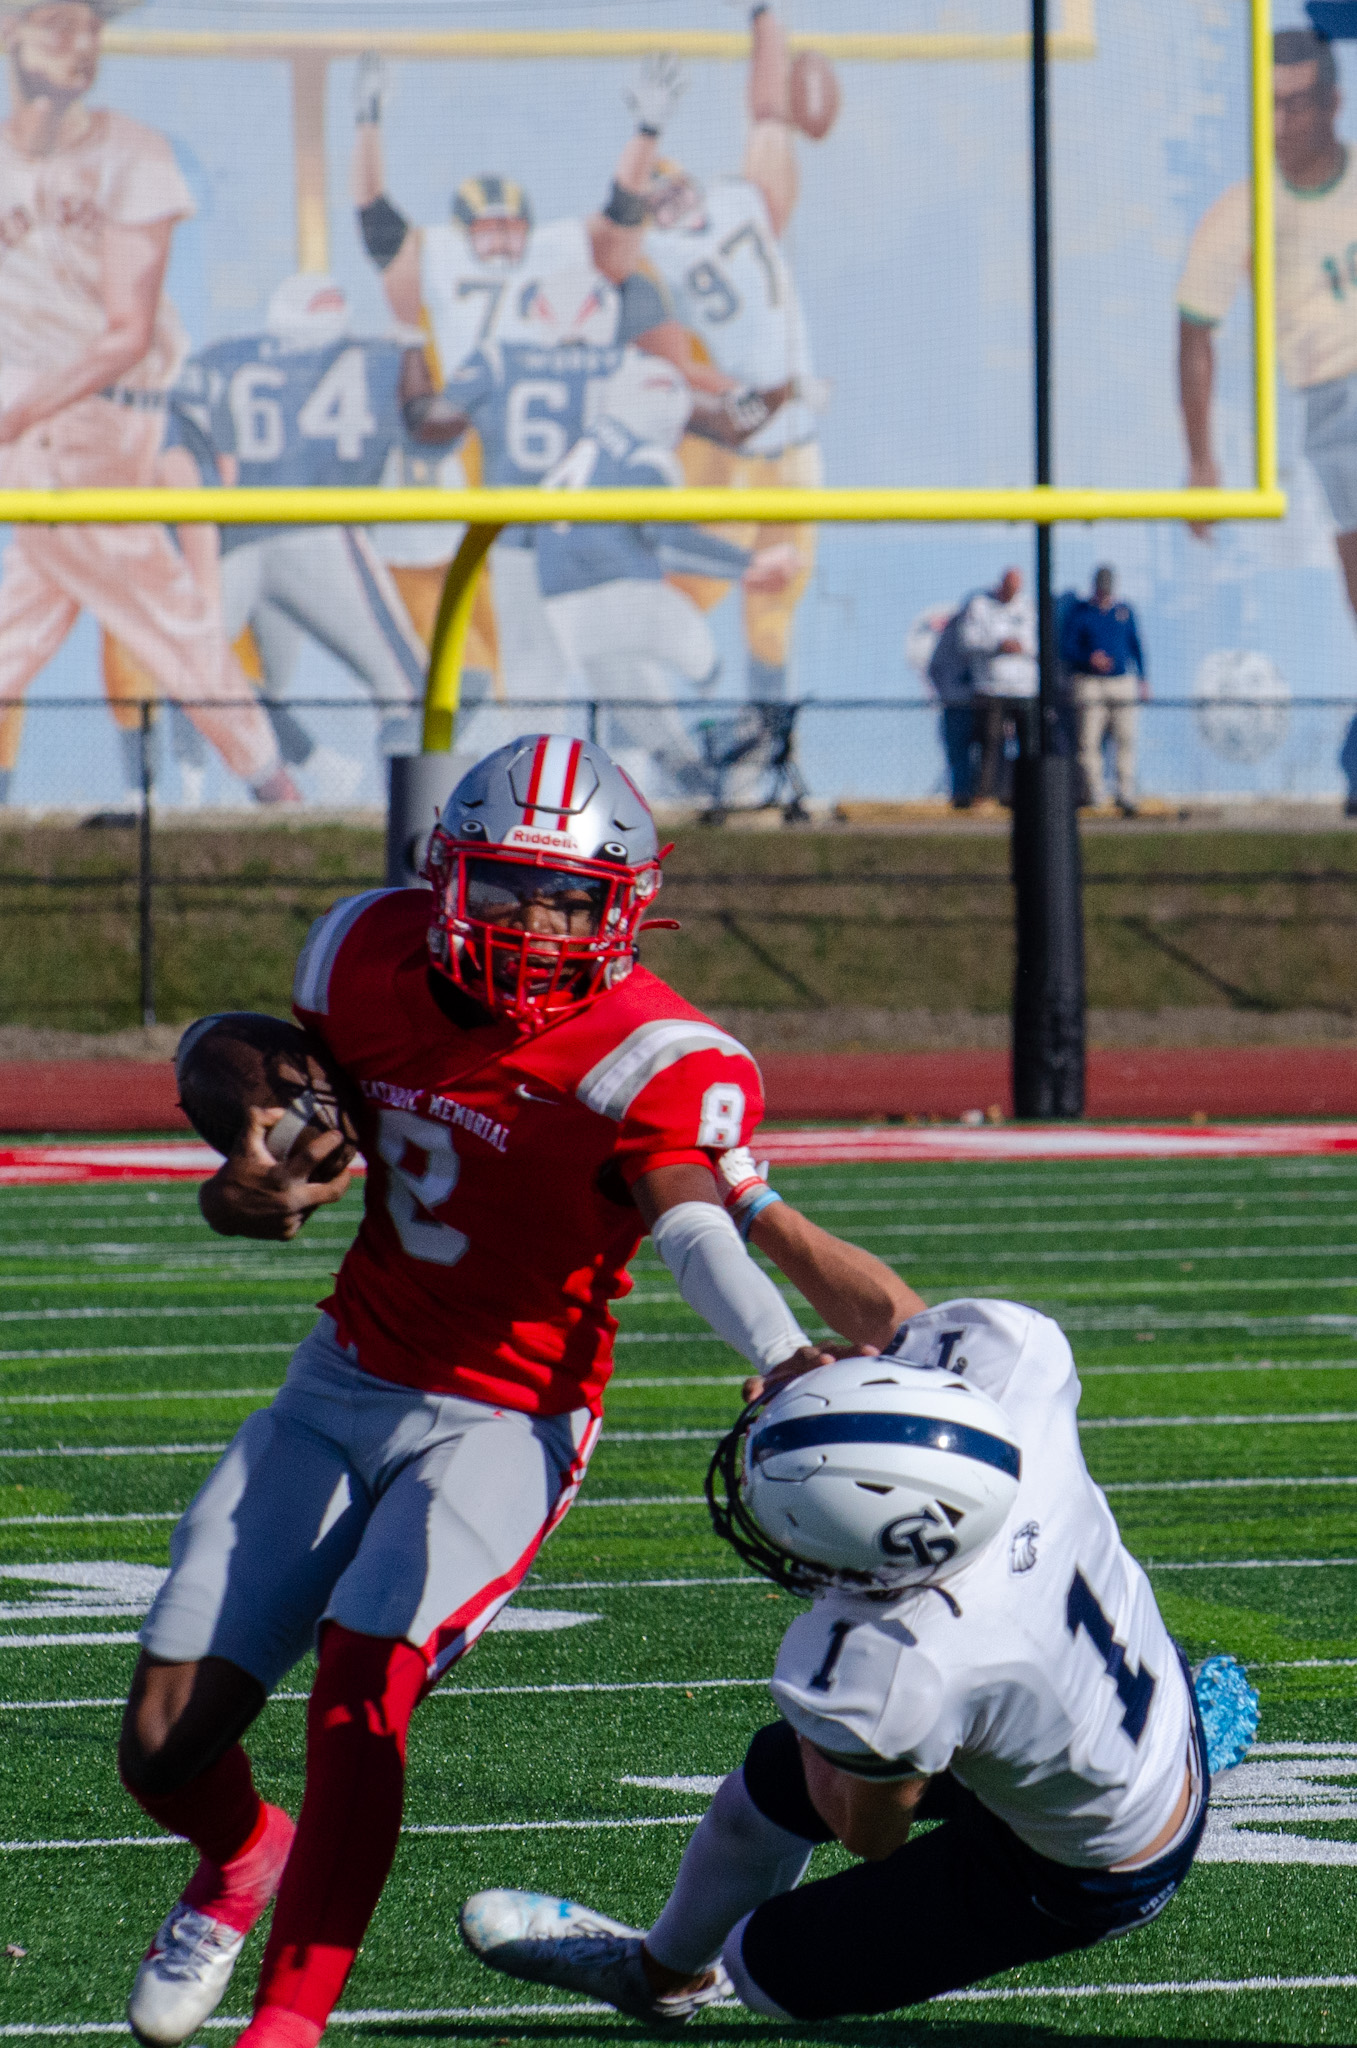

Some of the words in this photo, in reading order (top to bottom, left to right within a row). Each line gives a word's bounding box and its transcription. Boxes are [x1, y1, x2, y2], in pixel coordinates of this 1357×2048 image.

[685, 221, 779, 324] 97
[230, 346, 376, 461] 64
[513, 830, 572, 849] Riddell
[427, 1094, 511, 1153] MEMORIAL
[694, 1081, 746, 1149] 8
[378, 1108, 471, 1268] 8
[1065, 1563, 1158, 1747] 1
